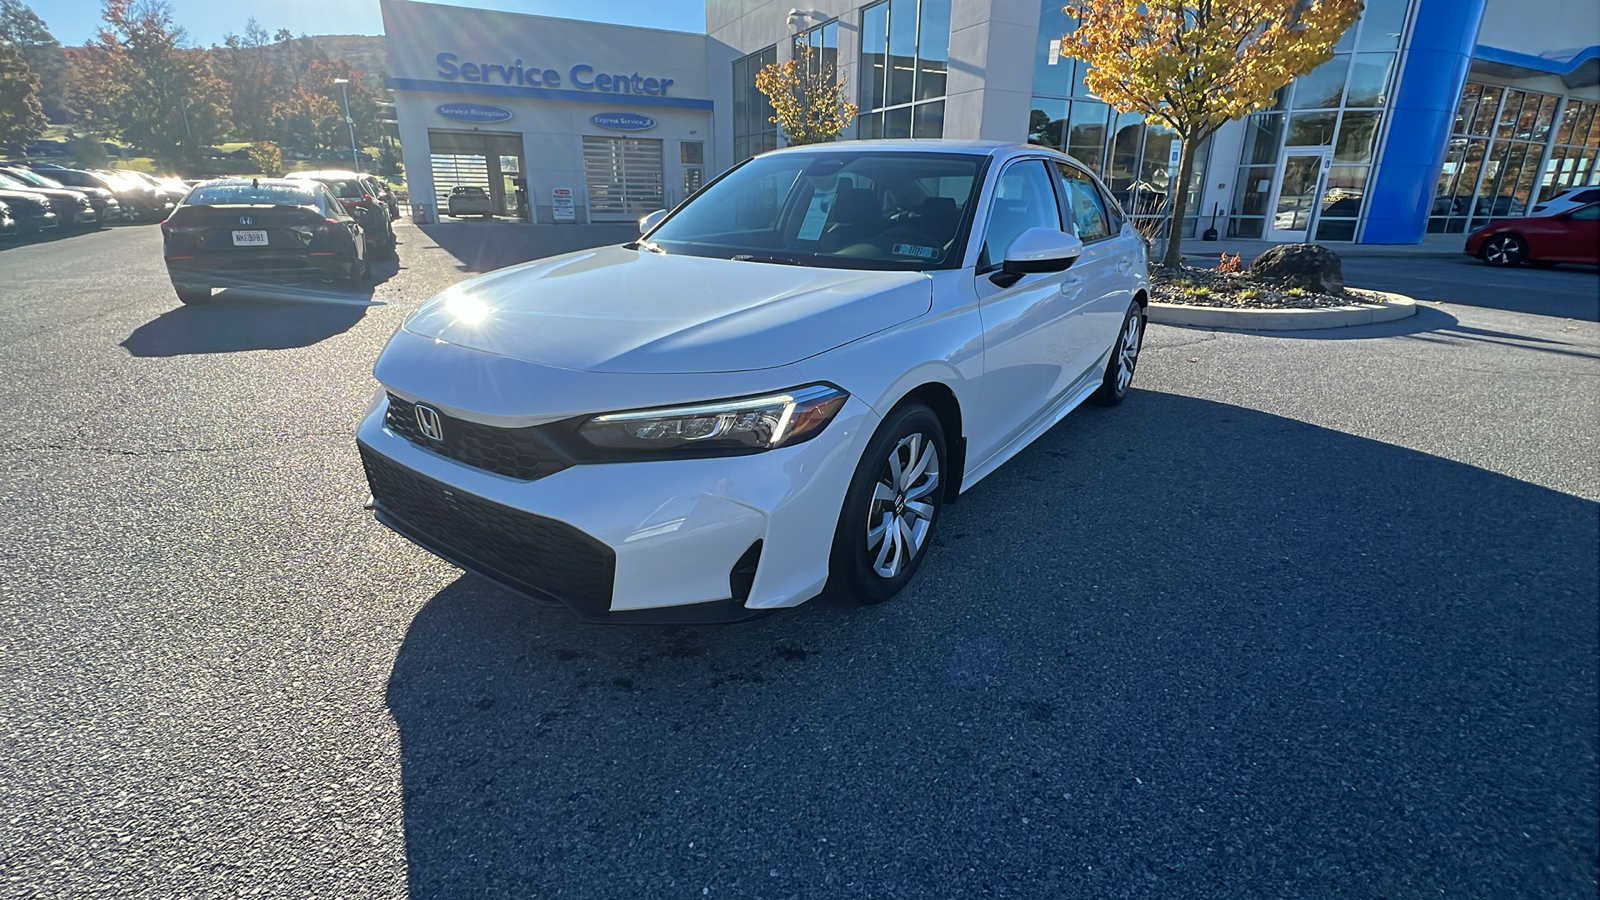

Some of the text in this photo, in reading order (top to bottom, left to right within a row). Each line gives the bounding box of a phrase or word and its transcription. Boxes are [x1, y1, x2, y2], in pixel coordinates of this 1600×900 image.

[436, 52, 675, 97] Service Center
[440, 107, 508, 118] Service Reception
[594, 117, 619, 125] Express
